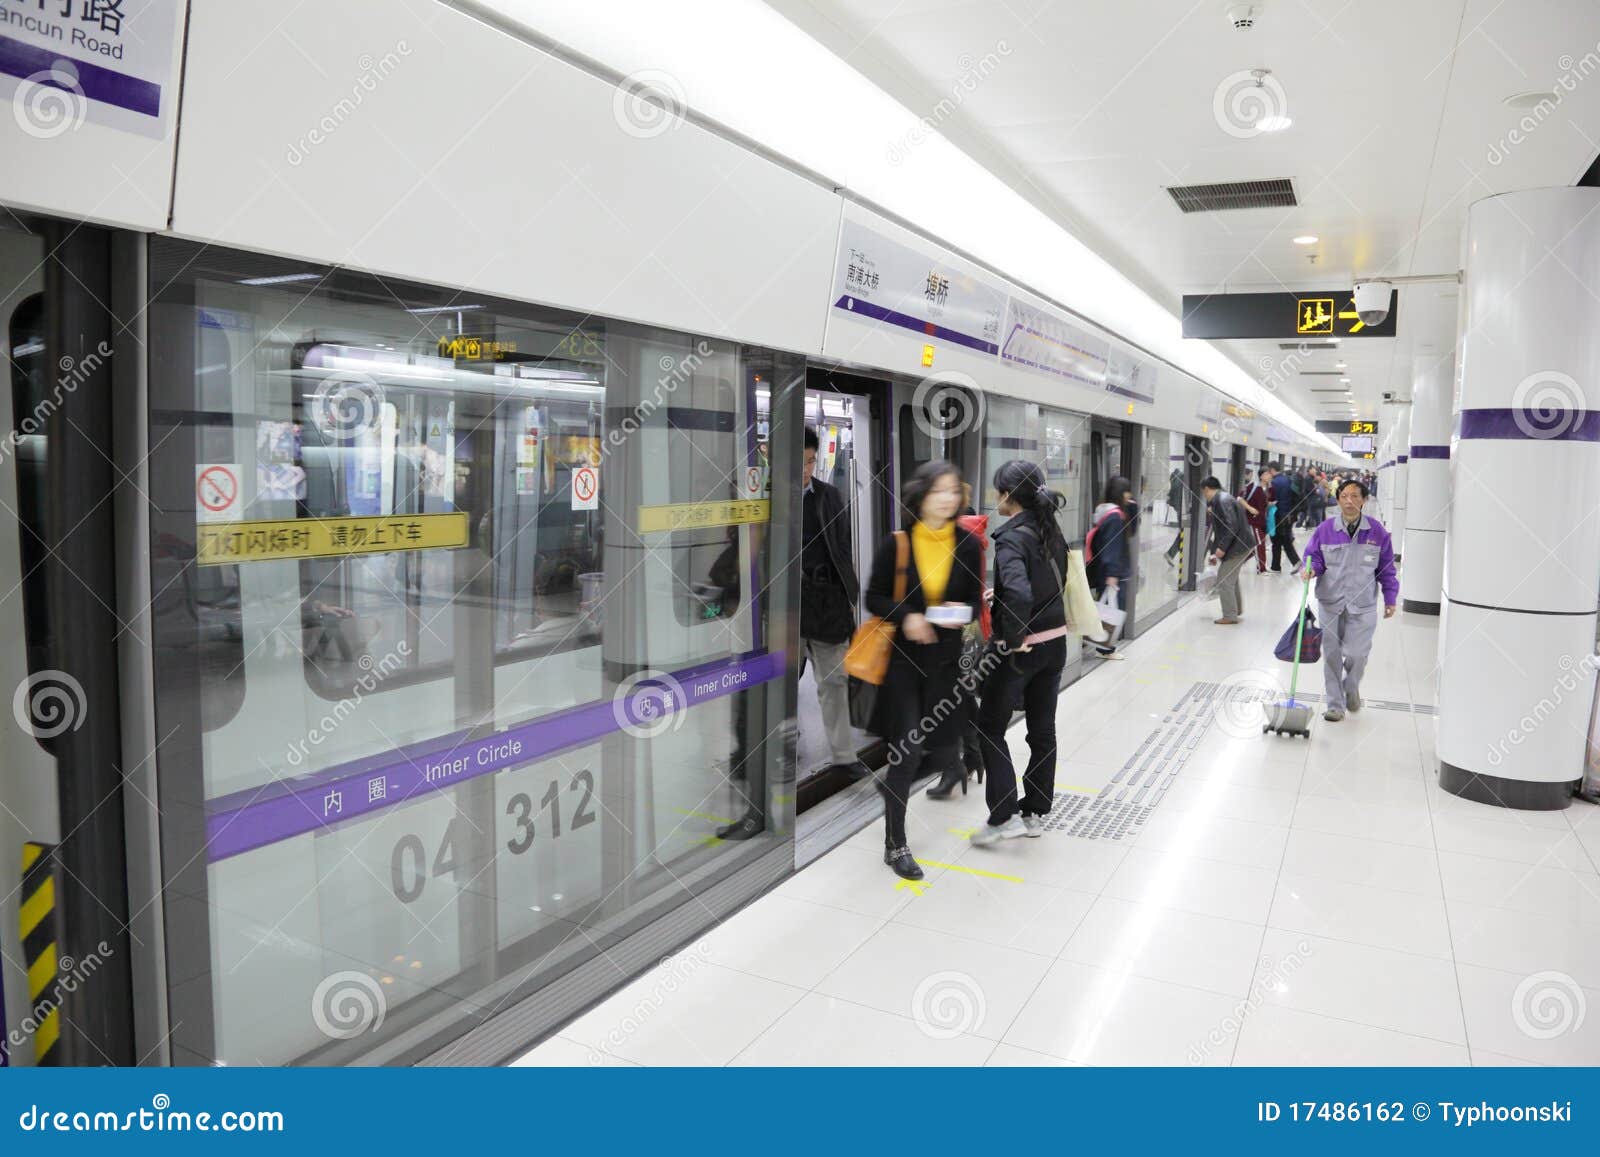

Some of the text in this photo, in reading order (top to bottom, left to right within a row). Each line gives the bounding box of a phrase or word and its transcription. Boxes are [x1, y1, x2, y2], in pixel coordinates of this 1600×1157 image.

[71, 28, 124, 60] Road
[329, 521, 422, 547] 请勿上下车
[694, 680, 718, 697] Inner
[721, 670, 748, 688] Circle
[425, 754, 470, 783] Inner
[476, 739, 522, 766] Circle
[506, 769, 597, 856] 312
